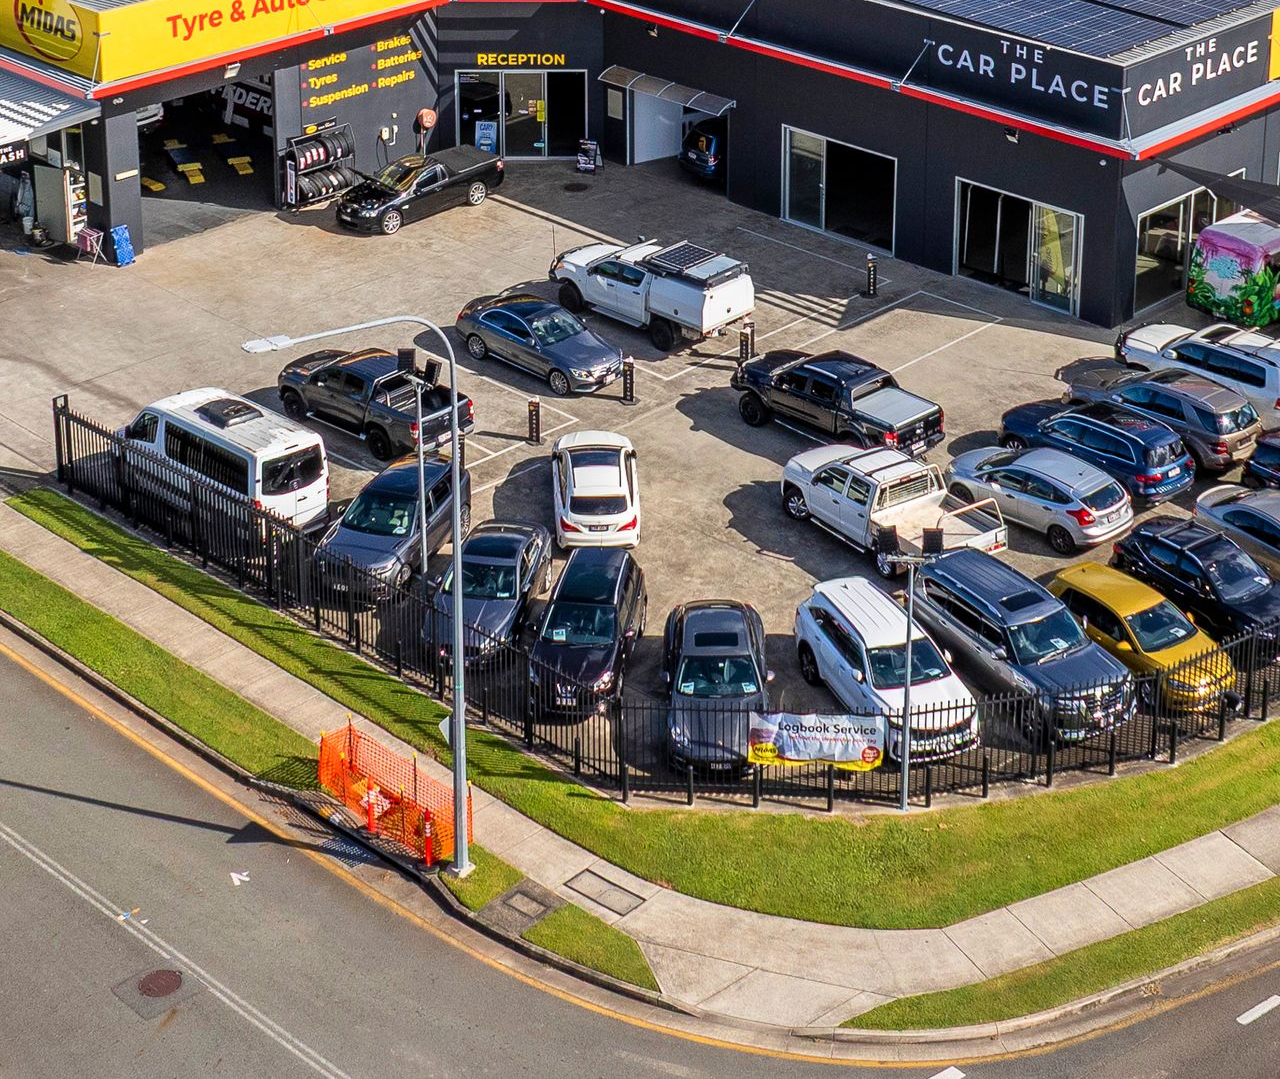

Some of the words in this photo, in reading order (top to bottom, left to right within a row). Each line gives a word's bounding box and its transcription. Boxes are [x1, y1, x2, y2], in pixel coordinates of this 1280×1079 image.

[166, 9, 222, 41] Tyre
[230, 0, 246, 22] &
[376, 35, 411, 52] Brakes
[1000, 40, 1044, 63] THE
[1185, 38, 1217, 61] THE
[308, 52, 347, 71] Service
[377, 49, 422, 70] Batteries
[477, 53, 566, 66] RECEPTION
[309, 72, 338, 90] Tyres
[378, 69, 415, 89] Repairs
[937, 44, 995, 78] CAR
[1010, 62, 1109, 109] PLACE
[1138, 72, 1182, 106] CAR
[1191, 40, 1259, 86] PLACE
[309, 82, 368, 108] Suspension
[778, 721, 830, 734] Logbook
[833, 723, 877, 736] Service
